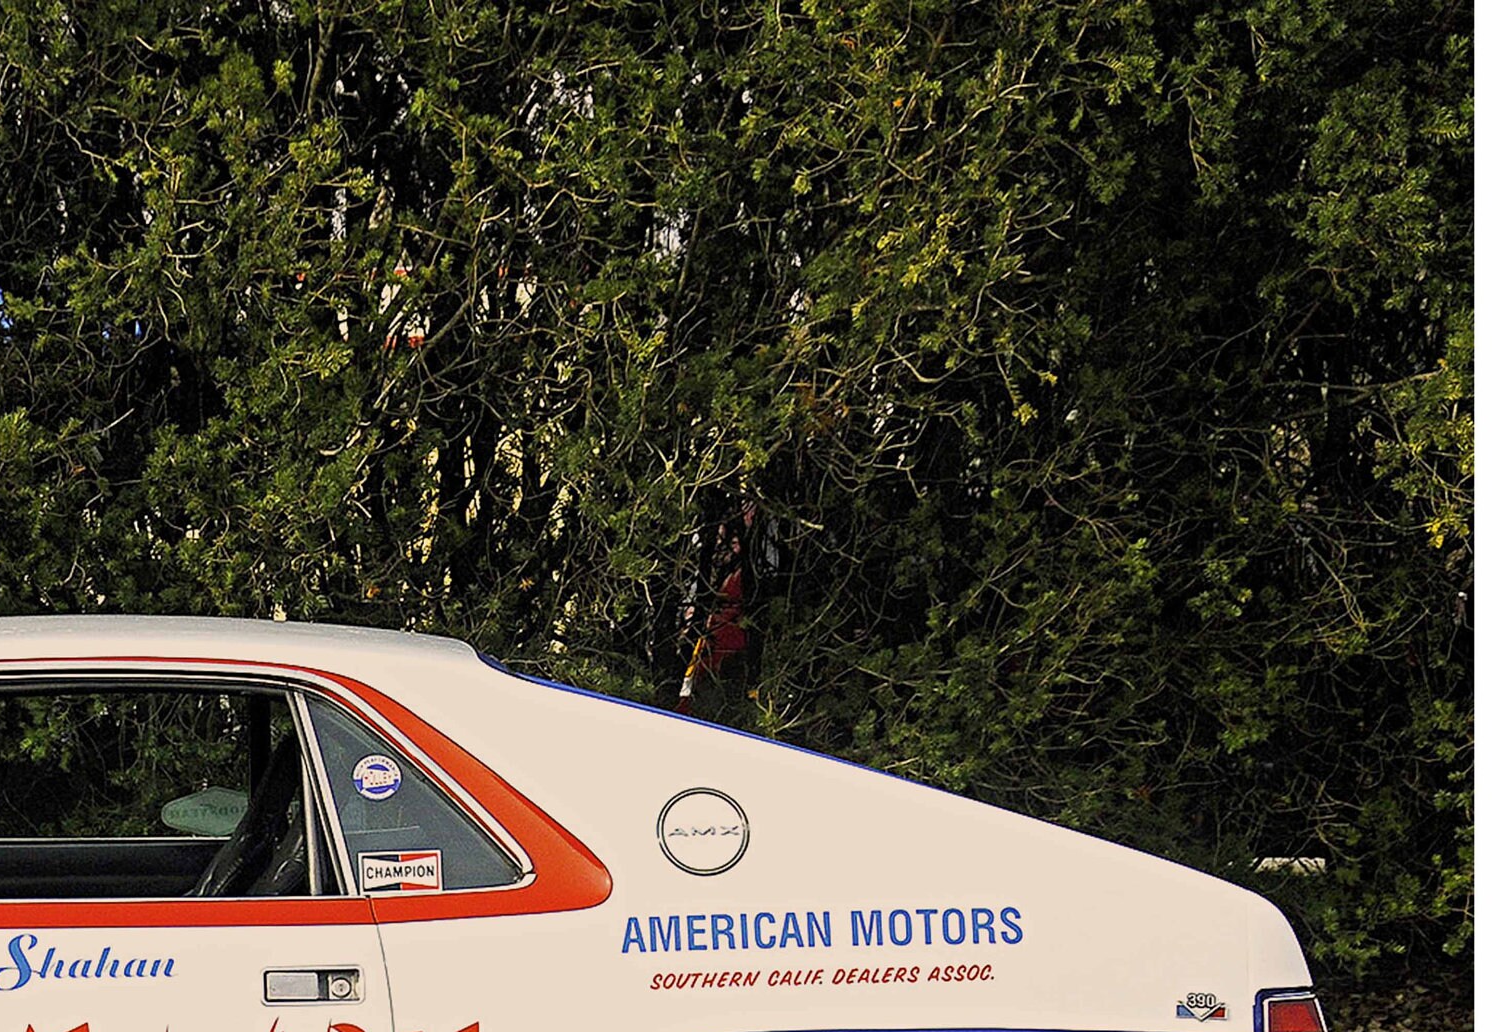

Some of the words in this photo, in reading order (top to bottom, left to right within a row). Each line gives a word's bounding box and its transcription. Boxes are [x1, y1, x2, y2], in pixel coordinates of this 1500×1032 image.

[668, 825, 740, 837] AMX
[366, 865, 435, 879] CHAMPION
[621, 911, 833, 953] AMERICAN
[850, 907, 1023, 946] MOTORS
[650, 970, 761, 990] SOUTHERN
[767, 970, 825, 987] CALIF.
[831, 967, 921, 986] DEALERS
[927, 964, 996, 983] ASSOC.
[1186, 992, 1217, 1009] 390
